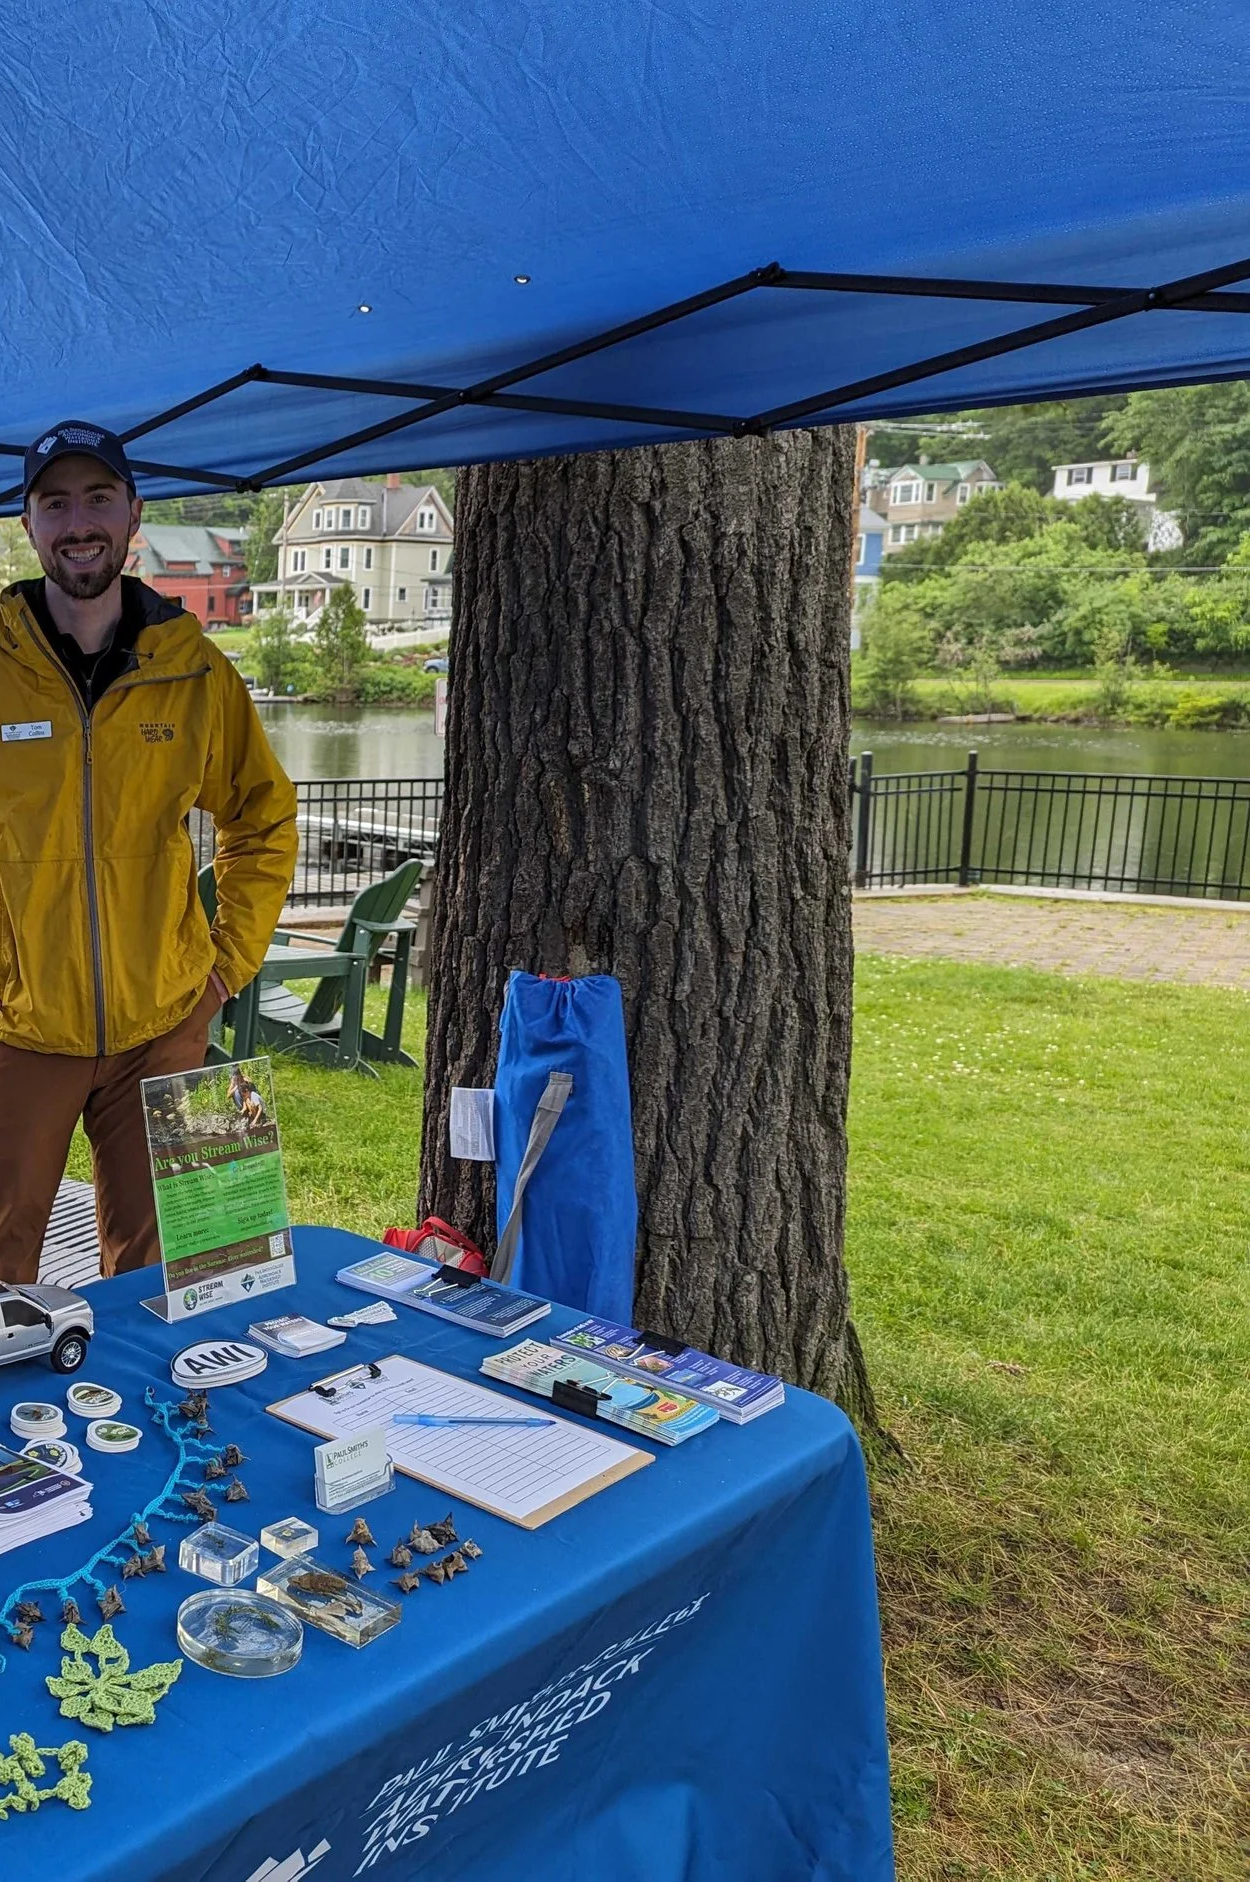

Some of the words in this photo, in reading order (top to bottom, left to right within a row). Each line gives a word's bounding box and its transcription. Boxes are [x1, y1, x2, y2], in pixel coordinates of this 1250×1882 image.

[155, 1156, 175, 1172] Are
[176, 1153, 199, 1169] you
[201, 1141, 241, 1160] Stream
[243, 1131, 275, 1150] Wise?
[197, 1279, 223, 1294] STREAM
[198, 1290, 213, 1300] WISE
[183, 1344, 256, 1374] AWI
[494, 1342, 544, 1365] PROTECT
[520, 1353, 553, 1369] YOUR
[530, 1354, 576, 1377] WATERS
[334, 1448, 348, 1459] PAUL
[335, 1451, 361, 1466] COLLEGE
[365, 1742, 453, 1811] PAUL
[583, 1592, 710, 1671] COLLEGE
[362, 1691, 612, 1852] WATRSHED
[352, 1734, 569, 1878] INSITUTE
